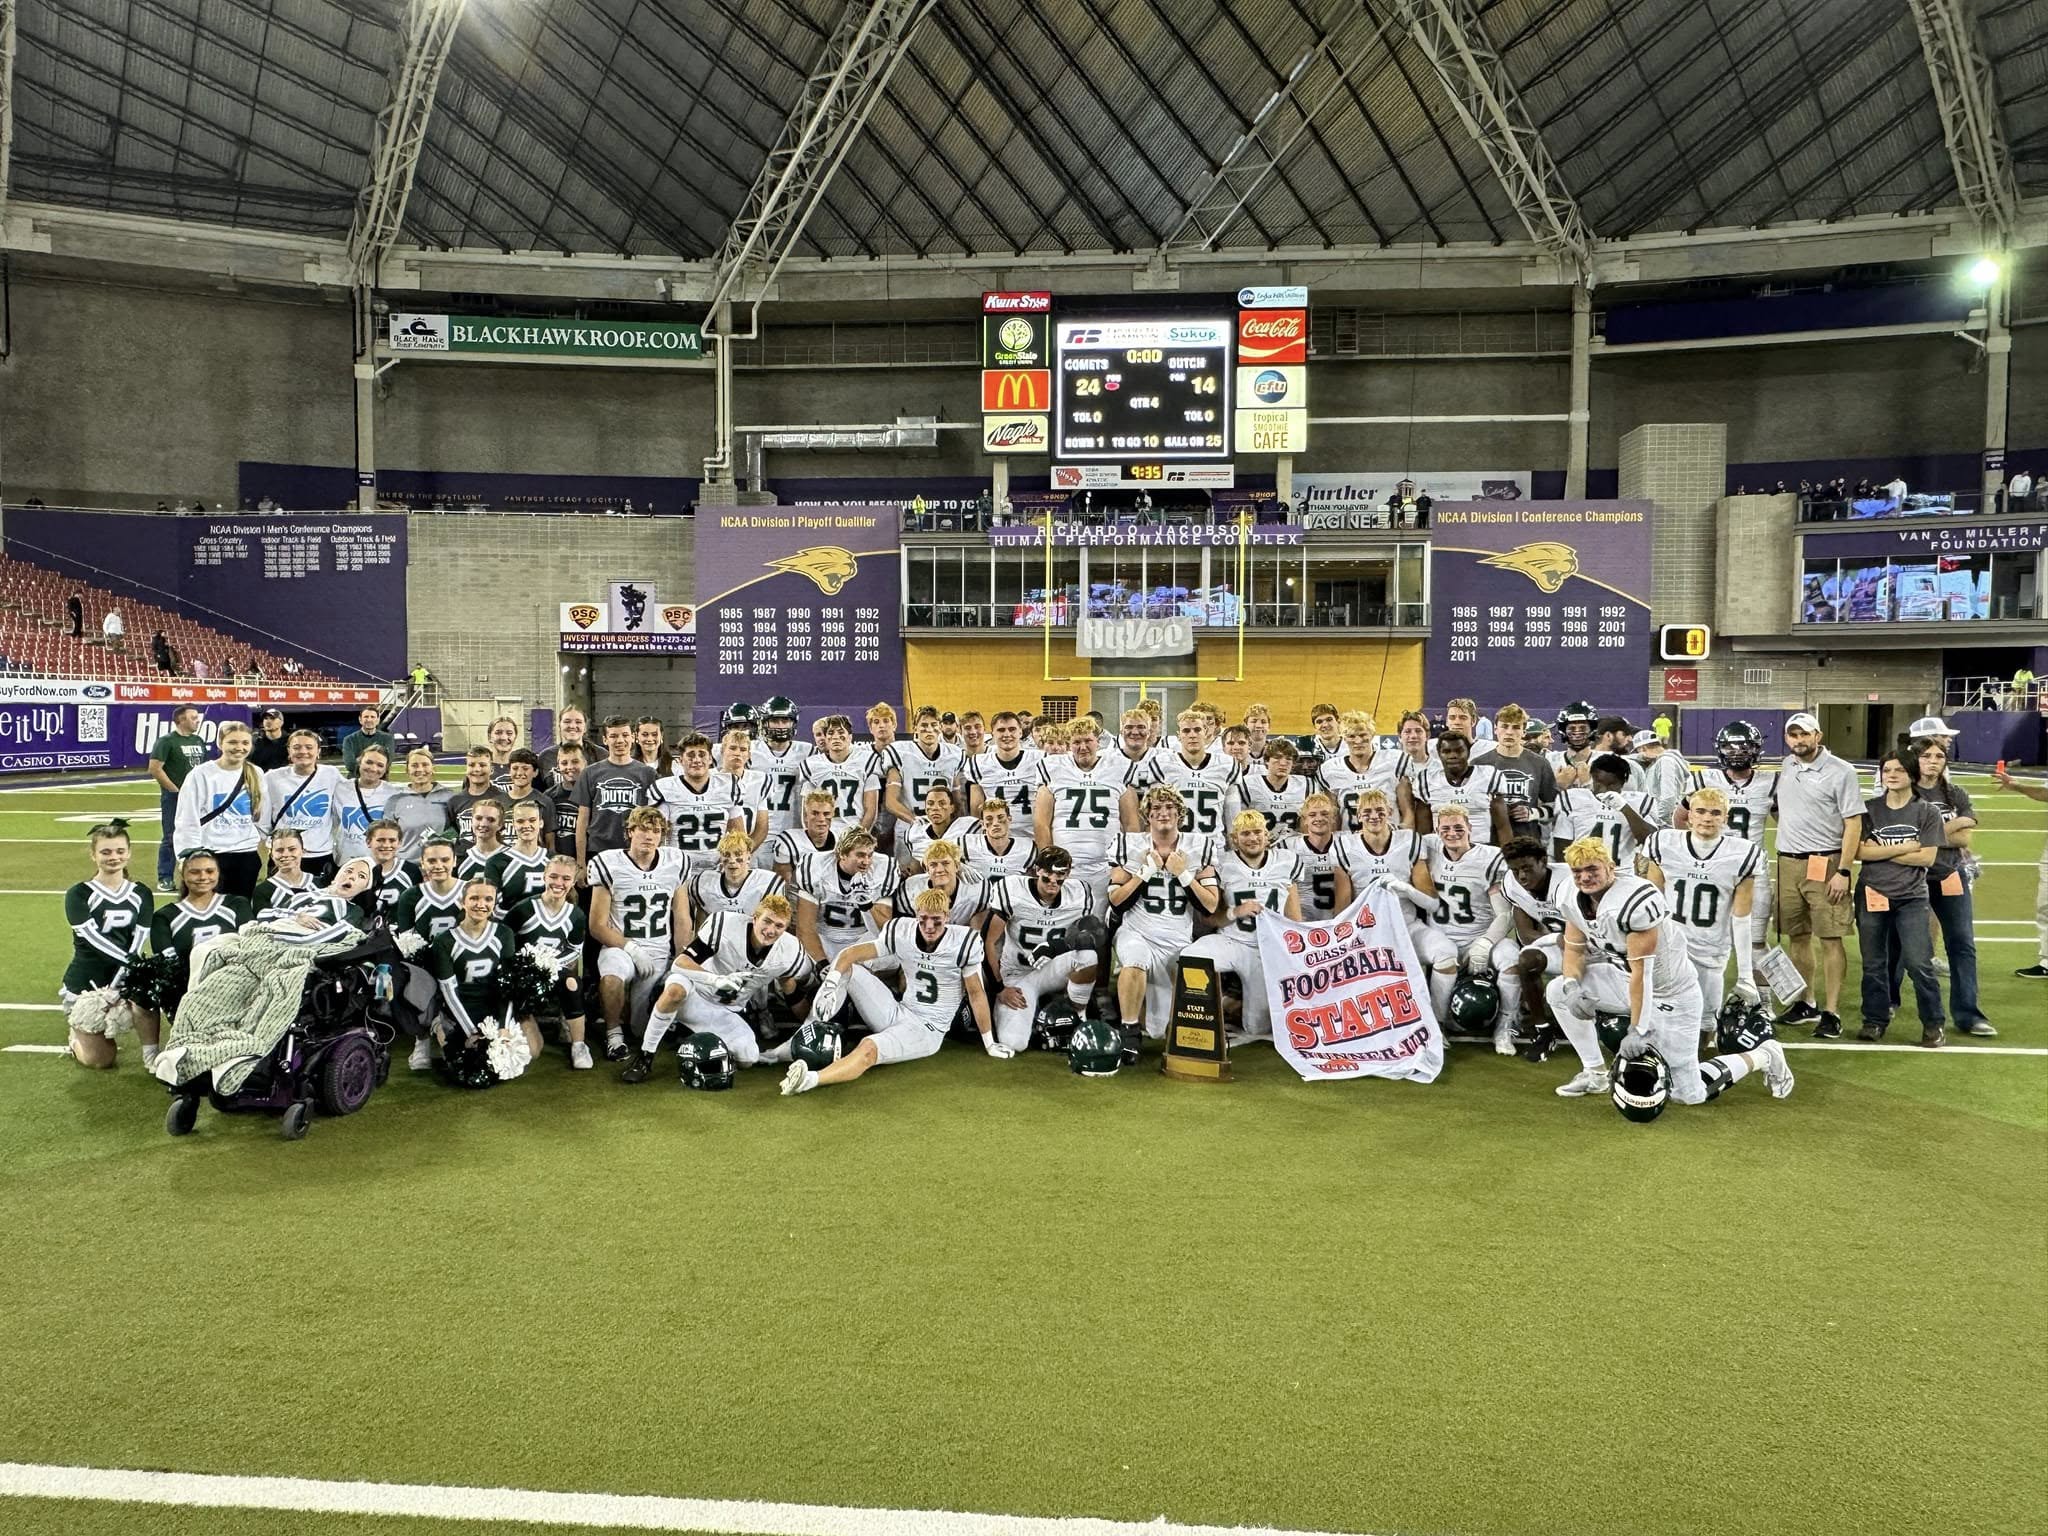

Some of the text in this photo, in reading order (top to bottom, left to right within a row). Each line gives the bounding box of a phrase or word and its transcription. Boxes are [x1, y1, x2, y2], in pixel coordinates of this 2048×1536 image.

[452, 325, 698, 350] BLACKHAWKROOF.COM
[1169, 327, 1217, 342] Sukup
[1126, 350, 1162, 364] 0:00
[1168, 358, 1206, 369] DUTCH
[1064, 359, 1110, 371] COMETS
[1076, 378, 1100, 397] 24
[1190, 376, 1216, 395] 14
[1073, 412, 1102, 423] TOL 0
[1184, 410, 1214, 422] TOL 0
[1253, 412, 1288, 423] tropical
[1253, 423, 1288, 432] SMOOTHIE
[1096, 436, 1104, 448] 1
[1142, 436, 1160, 448] 10
[1206, 435, 1222, 448] 25
[1253, 432, 1288, 449] CAFE
[1130, 466, 1161, 479] 9:35
[1306, 485, 1378, 501] further
[720, 516, 748, 528] NCAA
[751, 516, 790, 528] Division
[798, 516, 832, 530] Playoff
[834, 516, 876, 528] Qualifier
[1438, 512, 1468, 523] NCAA
[1470, 511, 1512, 523] Division
[1521, 511, 1582, 523] Conference
[1584, 510, 1644, 524] Champions
[210, 526, 232, 535] NCAA
[233, 525, 261, 535] Division
[290, 525, 330, 534] Conference
[332, 525, 373, 535] Champions
[1038, 526, 1118, 537] RICHARD
[1155, 526, 1254, 537] JACOBSON
[1899, 531, 1930, 542] VAN
[1940, 530, 1956, 540] G.
[1966, 526, 2028, 538] MILLER
[994, 536, 1055, 546] HUMAN
[1066, 535, 1202, 546] PERFORMANCE
[1930, 537, 2042, 550] FOUNDATION
[570, 609, 598, 619] PSC
[719, 608, 880, 619] 1985 1987 1990 1991 1992
[1451, 607, 1626, 618] 1985 1987 1990 1991 1992
[719, 622, 880, 633] 1993 1994 1995 1996 2001
[1451, 621, 1626, 633] 1993 1994 1995 1996 2001
[563, 634, 590, 642] INVEST
[617, 635, 650, 643] SUCCESS
[719, 637, 880, 647] 2003 2005 2007 2008 2010
[1450, 636, 1626, 647] 2003 2005 2007 2008 2010
[719, 650, 880, 661] 2011 2014 2015 2017 2018
[1450, 650, 1476, 662] 2011
[719, 664, 778, 675] 2019 2021
[87, 686, 106, 698] Ford
[15, 714, 33, 744] it
[32, 704, 65, 742] up!
[2, 754, 110, 768] CASINO RESORTS
[604, 788, 636, 804] DUTCH
[1066, 789, 1110, 828] 75
[676, 812, 726, 850] 25
[1686, 872, 1709, 880] PELLA
[1144, 878, 1188, 916] 56
[1432, 882, 1475, 924] 53
[1672, 880, 1719, 928] 10
[622, 894, 670, 938] 22
[1645, 900, 1662, 924] 11
[101, 910, 133, 933] P
[1283, 904, 1376, 954] 2024
[1304, 946, 1348, 966] CLASS
[465, 958, 494, 984] P
[1280, 948, 1408, 1007] FOOTBALL
[915, 970, 938, 1004] 3
[1186, 1004, 1205, 1012] STATE
[1178, 1012, 1214, 1021] RUNNER-UP
[1285, 980, 1422, 1050] STATE
[1300, 1024, 1431, 1062] RUNNER-UP
